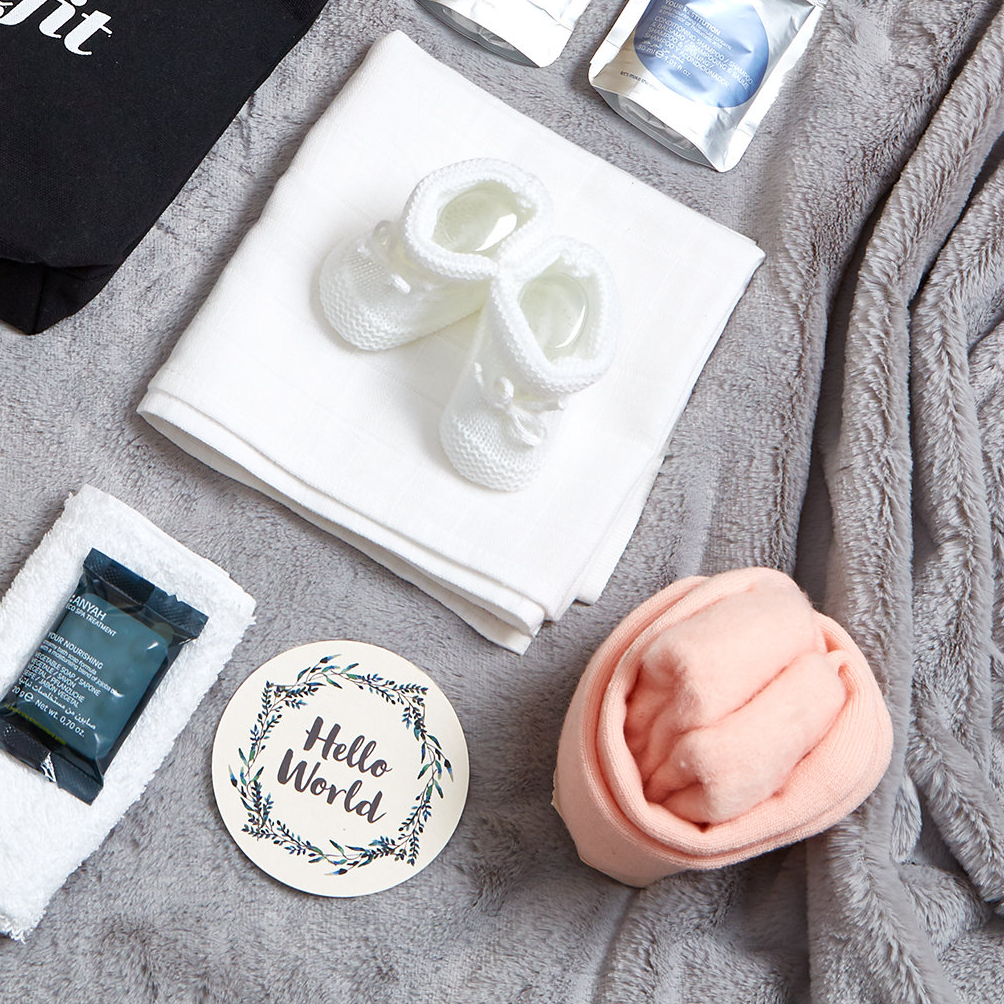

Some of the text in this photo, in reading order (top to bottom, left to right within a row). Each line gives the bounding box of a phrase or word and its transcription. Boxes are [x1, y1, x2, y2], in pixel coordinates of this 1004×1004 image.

[644, 30, 674, 51] SHAMPOO
[648, 24, 677, 45] SHAMPOO
[654, 13, 695, 42] CONDITIONING
[695, 39, 724, 60] SHAMPOO
[663, 56, 675, 67] 1.01
[75, 608, 115, 636] SPA TREATMENT
[63, 640, 103, 669] NOURISHING
[31, 657, 75, 687] VEGETALE SAVON
[35, 651, 61, 670] VEGETABLE
[60, 667, 75, 679] SOAP
[77, 679, 100, 696] SAPONE
[56, 690, 79, 707] VEGETAL
[34, 699, 86, 736] Net wt. oz.
[303, 716, 393, 777] Hello
[277, 748, 386, 824] World
